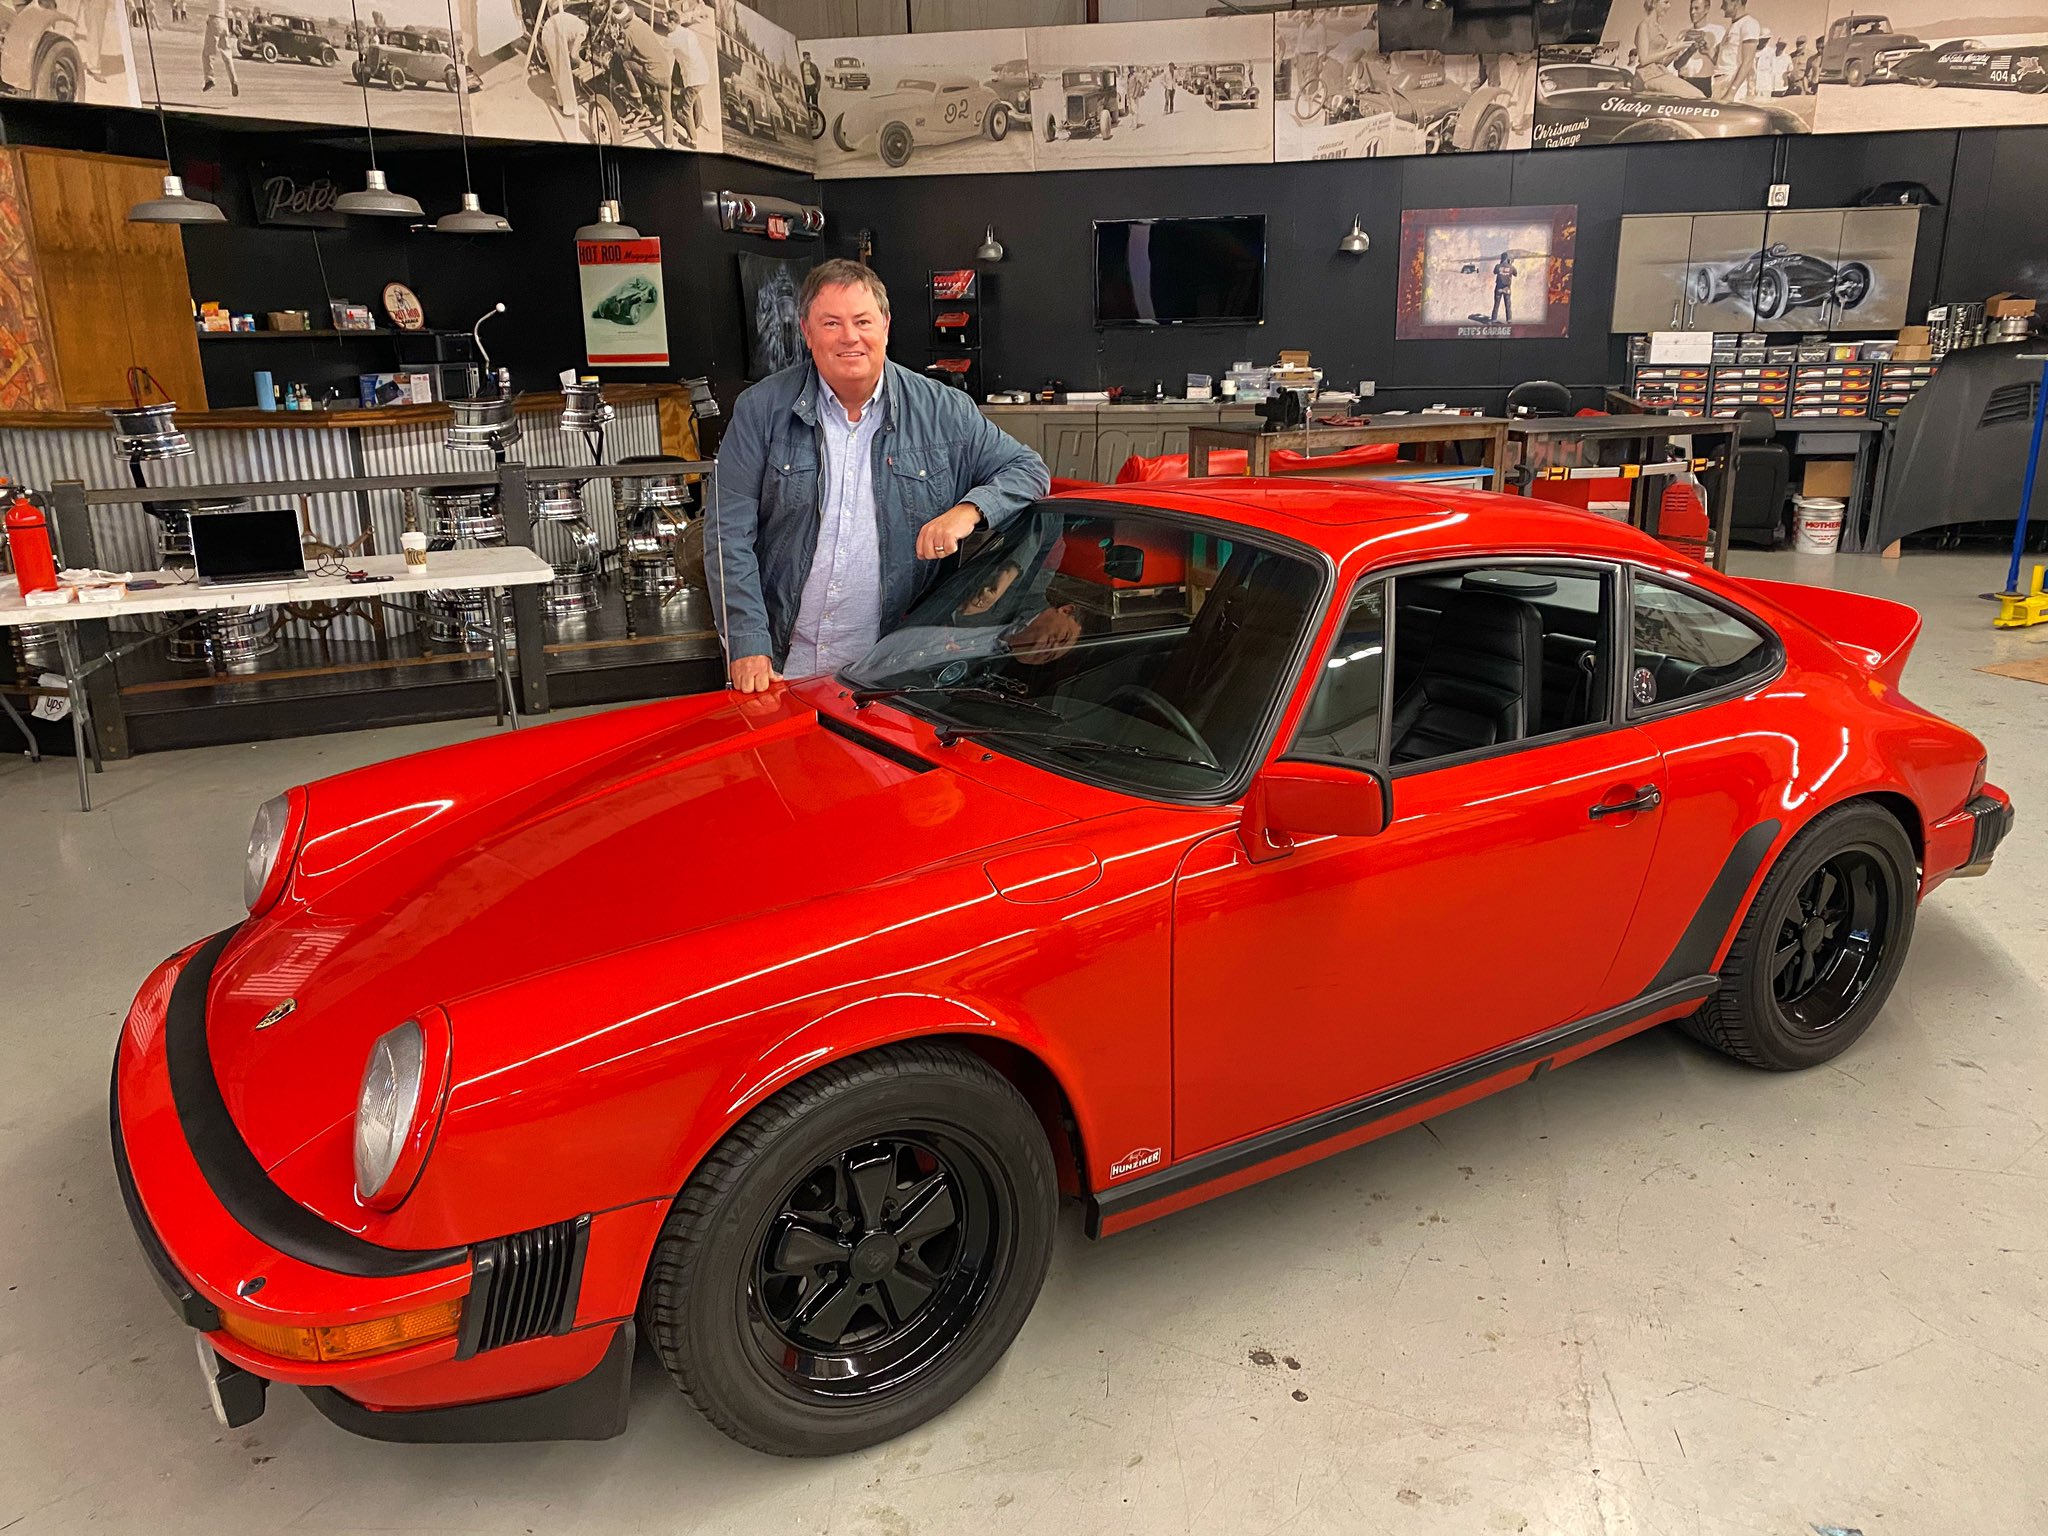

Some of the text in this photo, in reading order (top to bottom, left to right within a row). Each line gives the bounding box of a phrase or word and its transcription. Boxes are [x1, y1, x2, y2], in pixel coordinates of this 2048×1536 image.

[1990, 70, 2009, 82] 404
[944, 99, 969, 124] 92
[1601, 97, 1720, 118] Sharp EQUIPPED
[1533, 117, 1590, 141] Chrisman's
[1545, 134, 1581, 148] Garage
[579, 245, 599, 263] HOT
[601, 245, 622, 262] ROD
[1458, 326, 1512, 336] PETE'S GARAGE
[1112, 1151, 1160, 1176] HUNZIKER
